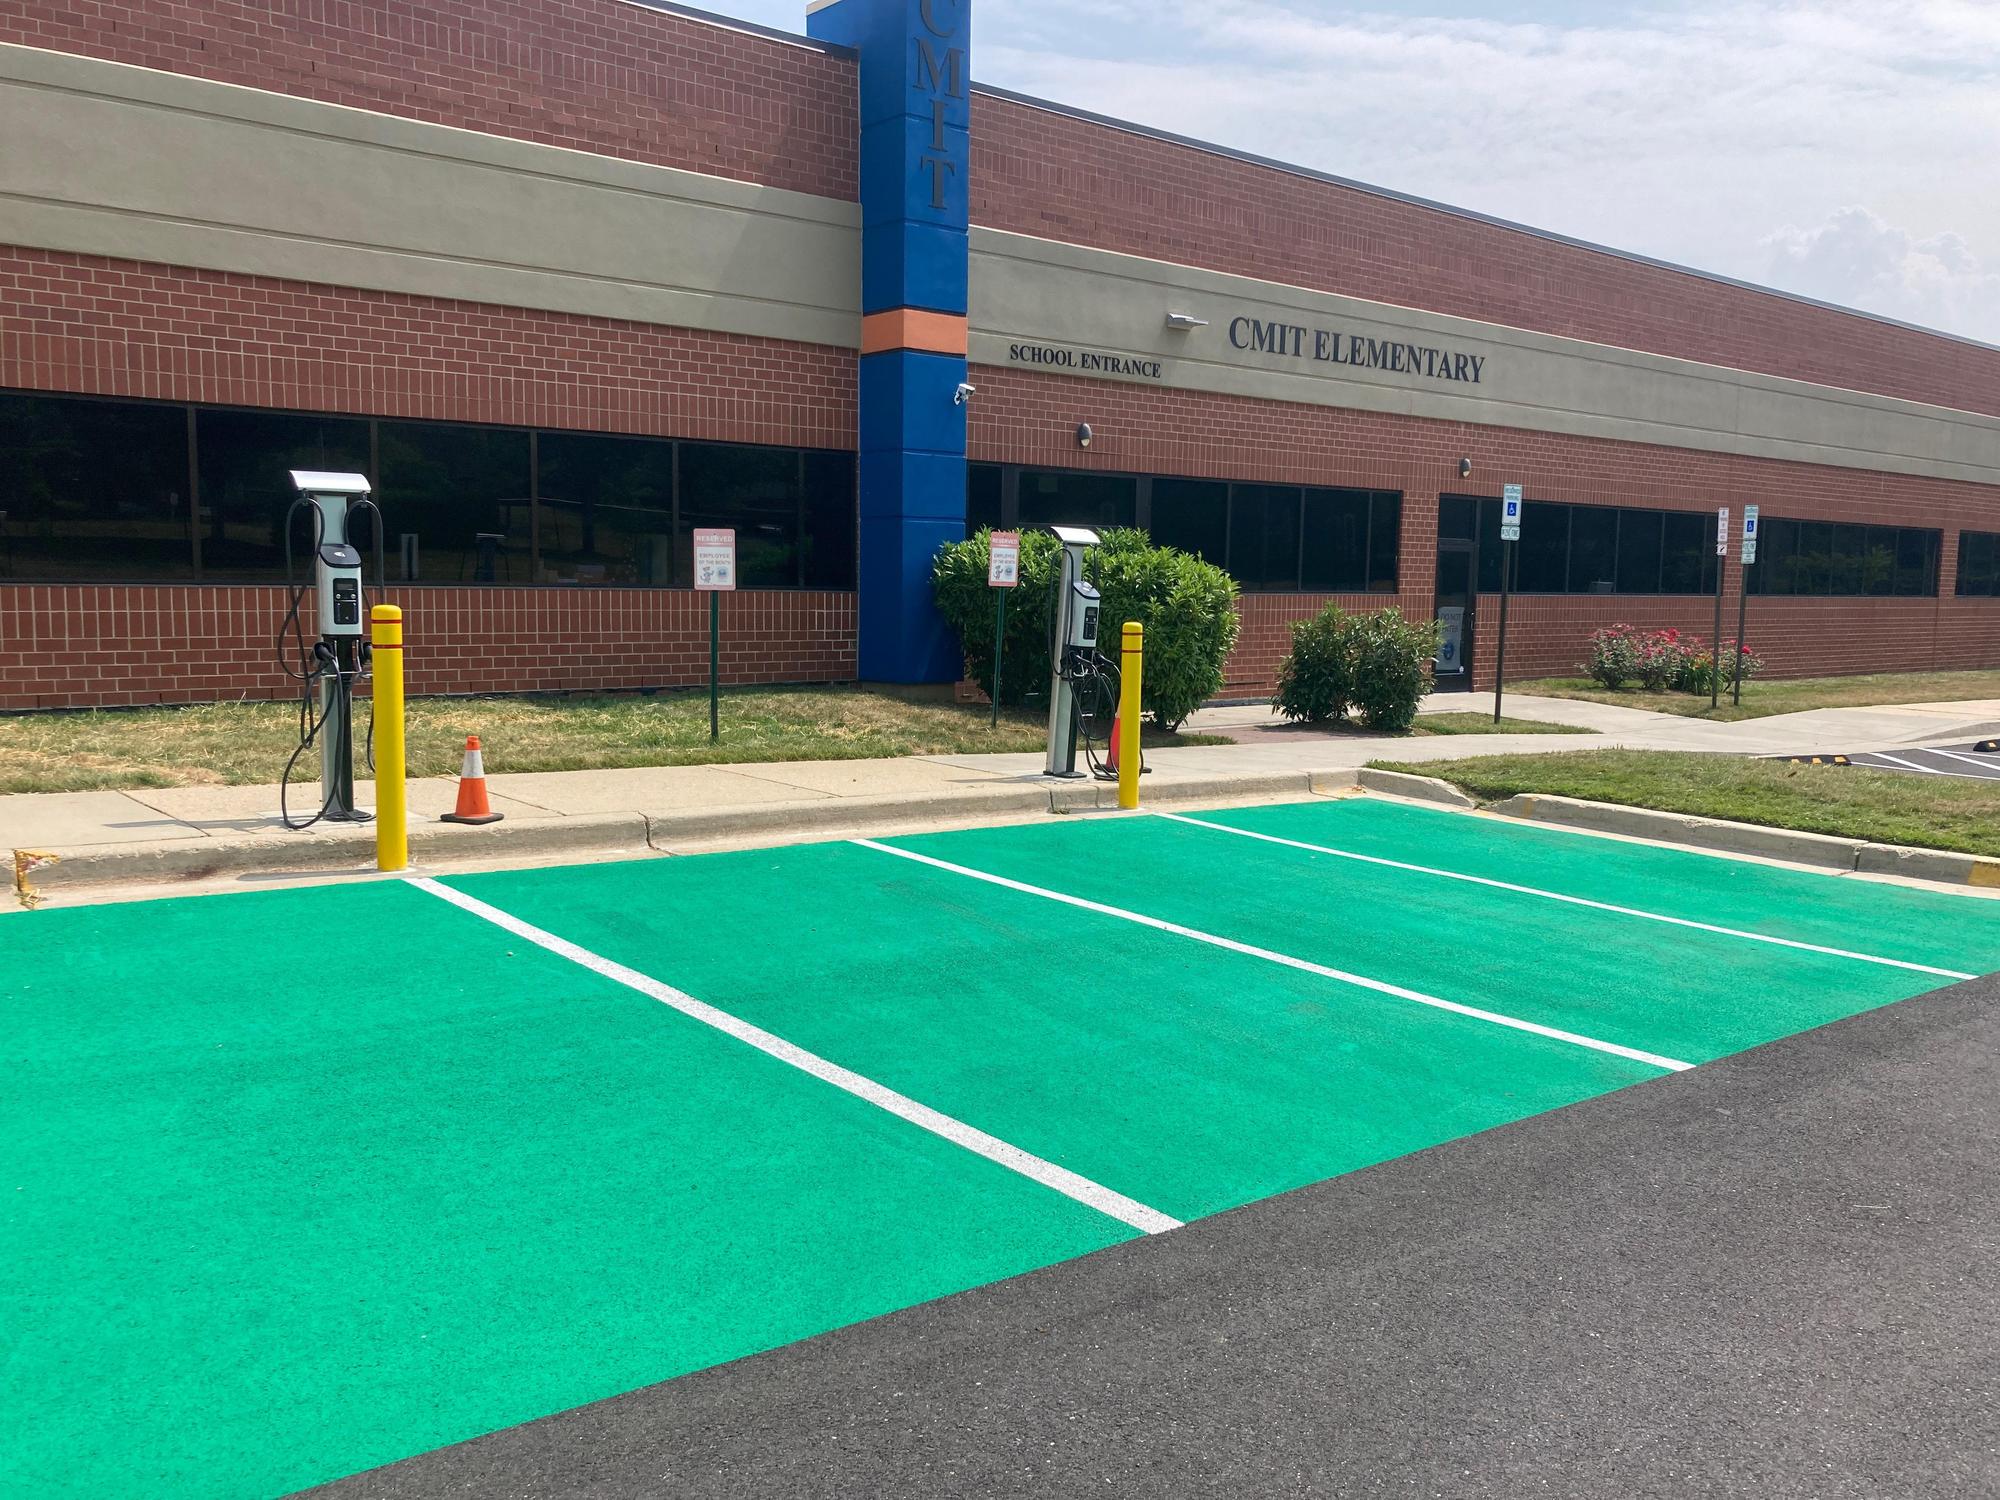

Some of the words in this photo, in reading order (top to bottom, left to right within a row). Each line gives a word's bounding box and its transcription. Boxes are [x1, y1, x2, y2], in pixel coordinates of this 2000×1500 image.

[912, 0, 965, 210] CMIT
[1010, 344, 1077, 367] SCHOOL
[1081, 353, 1162, 378] ENTRANCE
[1229, 316, 1307, 357] CMIT
[1313, 329, 1486, 383] ELEMENTARY
